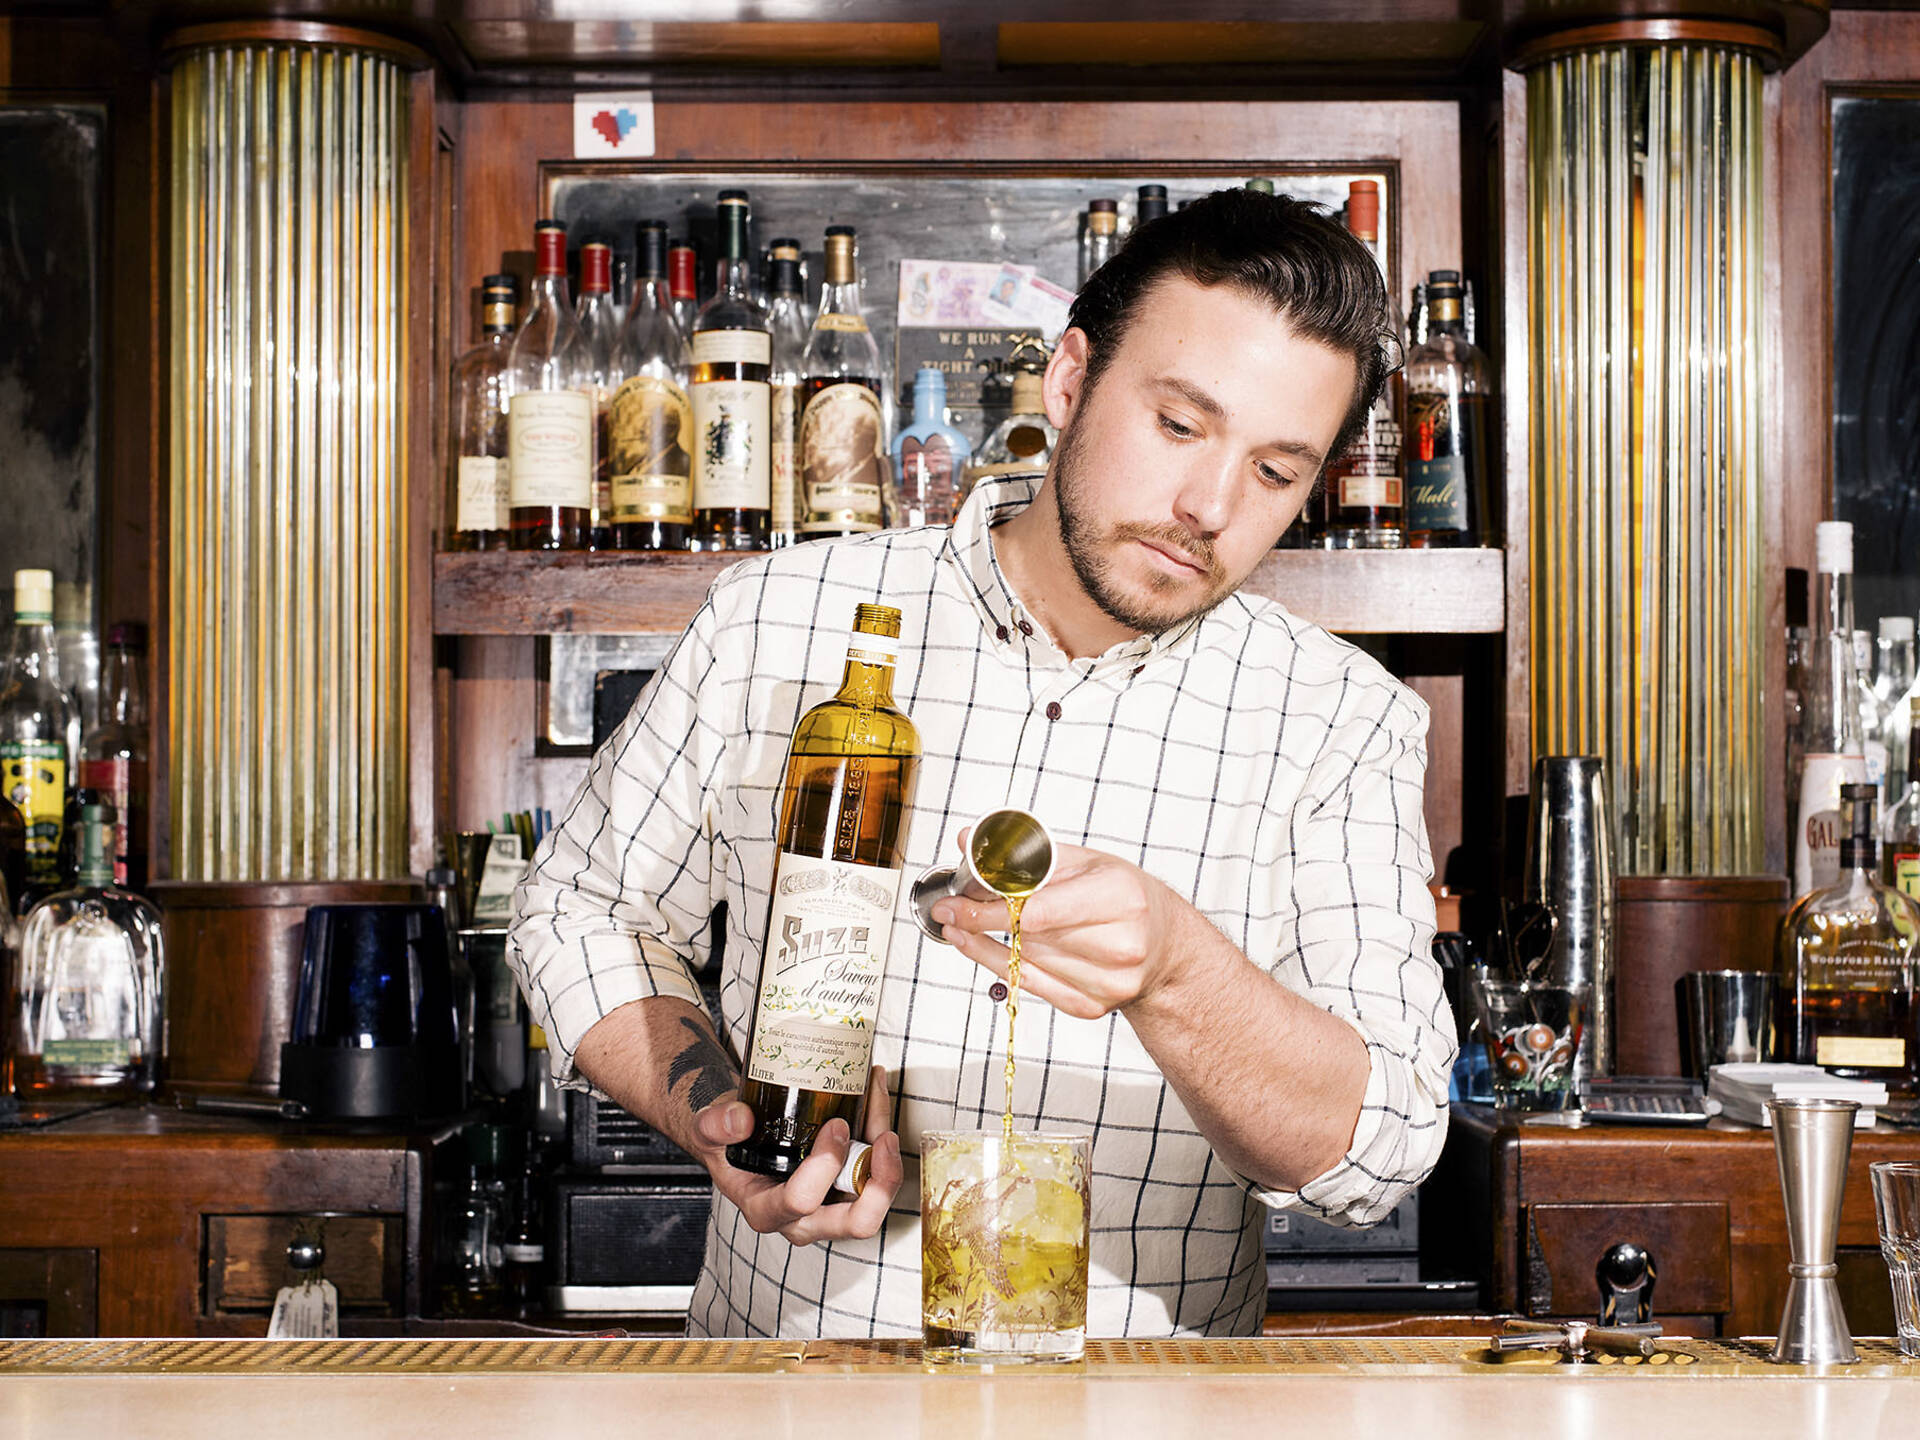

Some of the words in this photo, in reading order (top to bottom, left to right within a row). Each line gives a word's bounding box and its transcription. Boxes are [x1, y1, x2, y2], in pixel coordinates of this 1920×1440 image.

[939, 332, 962, 345] WE
[967, 332, 1001, 345] RUN
[964, 347, 975, 360] A
[922, 361, 974, 373] TIGHT
[1806, 816, 1838, 849] GAL
[824, 958, 880, 986] Saveur
[801, 980, 876, 1013] d'autrefois
